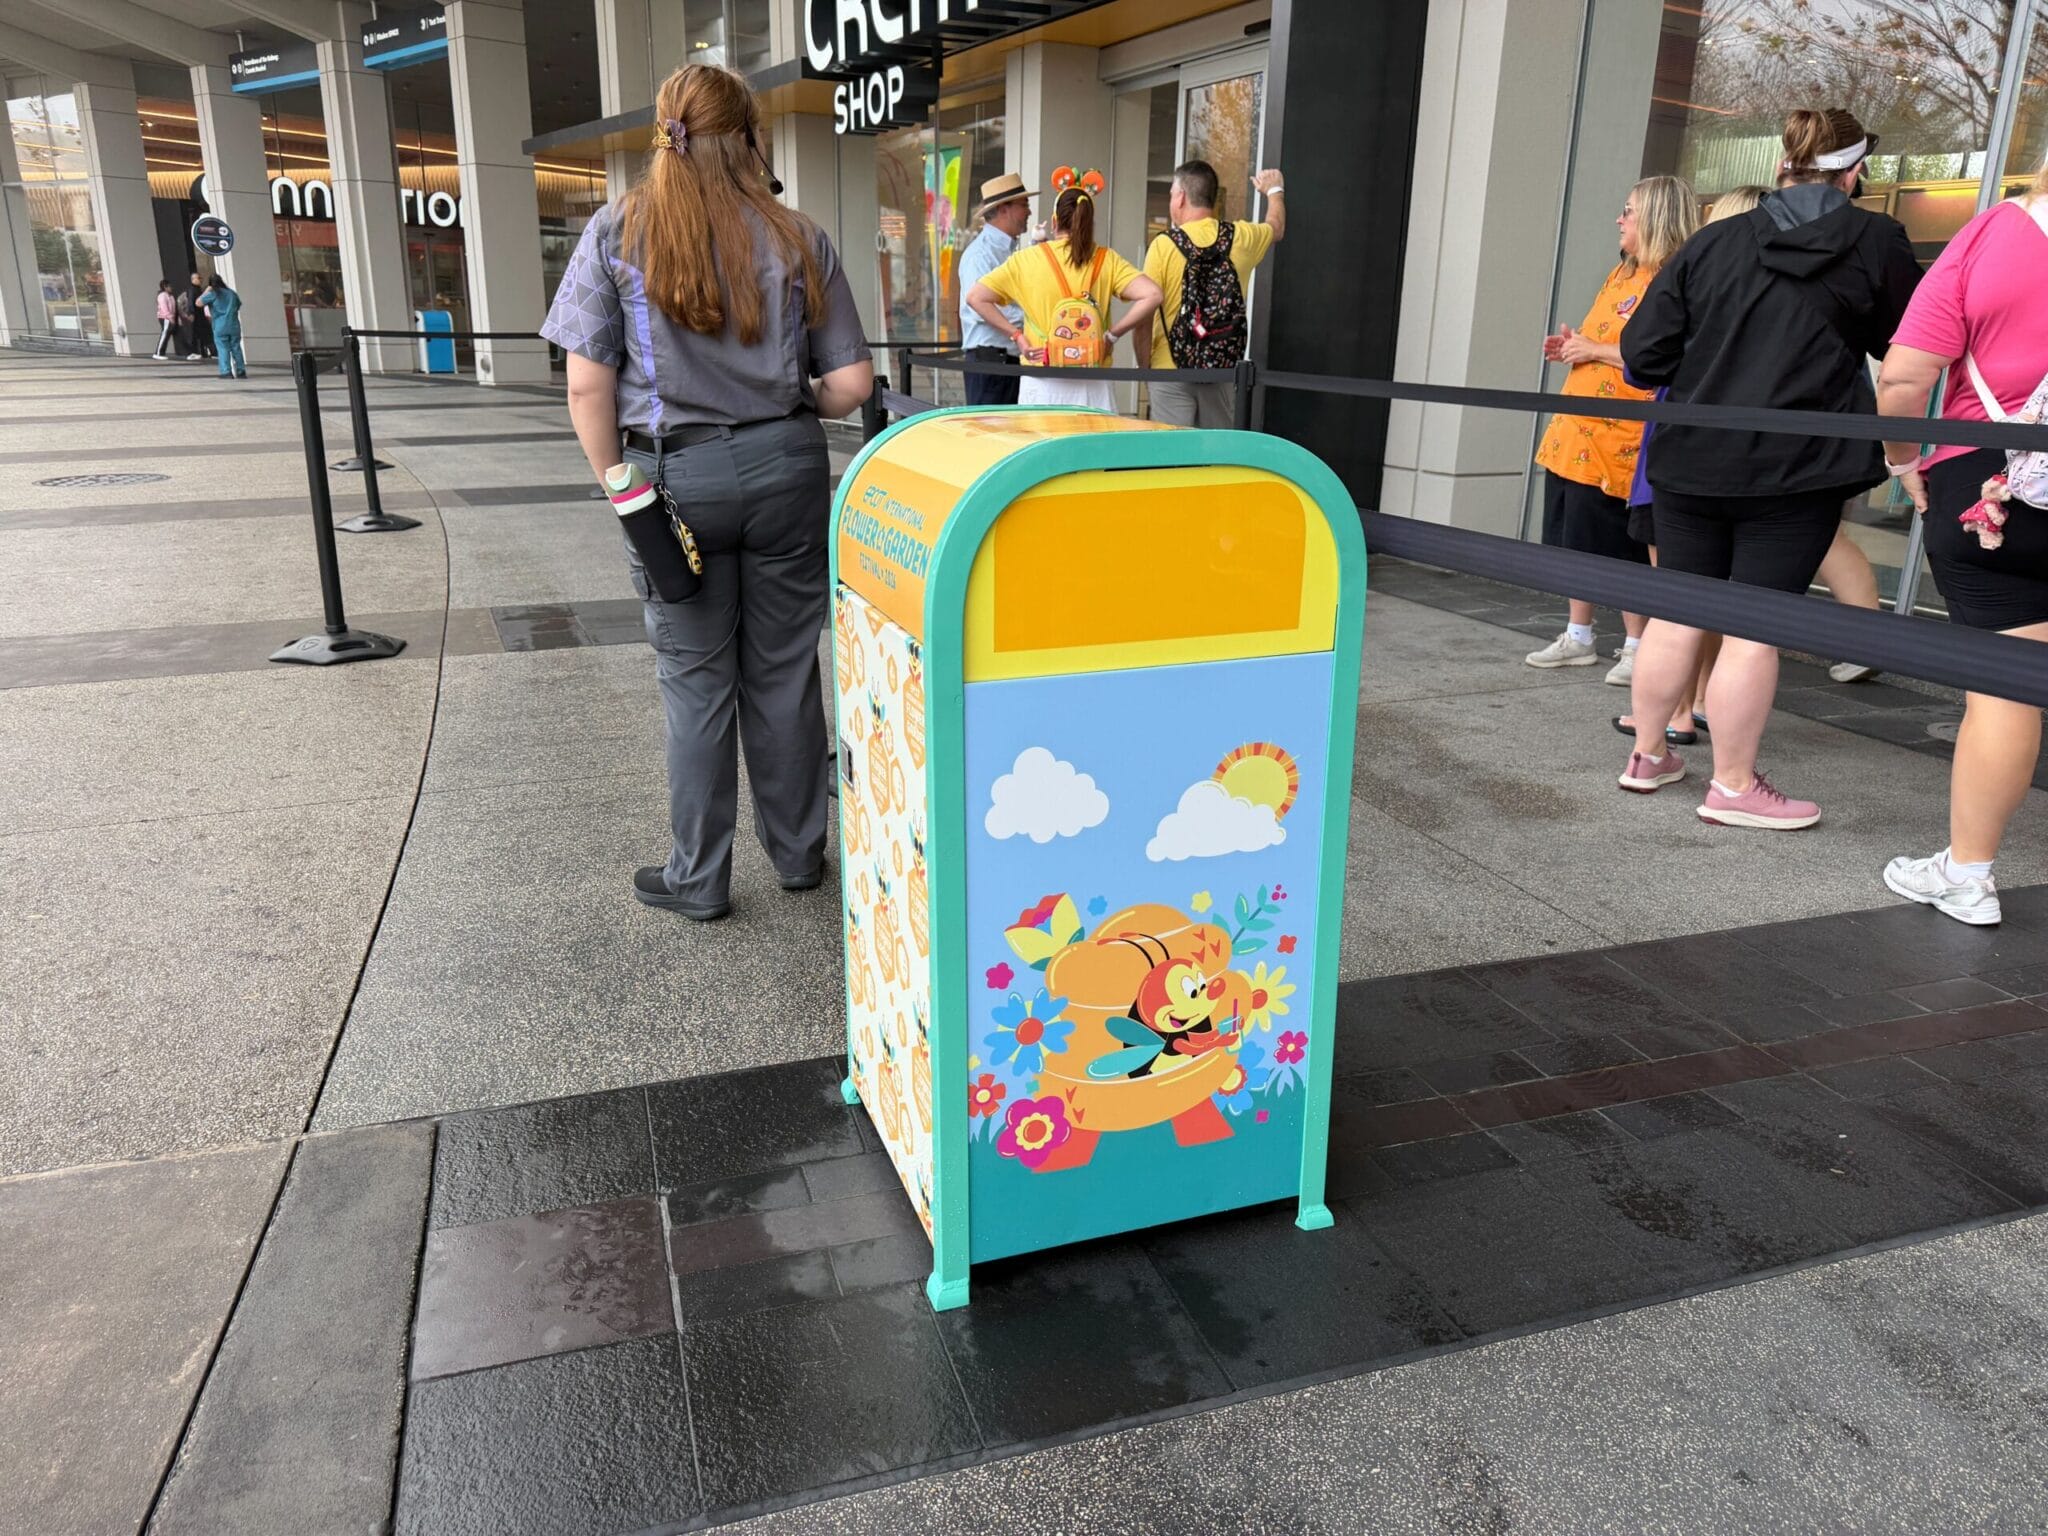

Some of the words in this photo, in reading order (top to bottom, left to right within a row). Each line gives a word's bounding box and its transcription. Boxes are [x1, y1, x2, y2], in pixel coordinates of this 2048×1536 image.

[834, 65, 904, 135] SHOP
[842, 505, 879, 549] FLOWER
[883, 527, 932, 578] GARDEN
